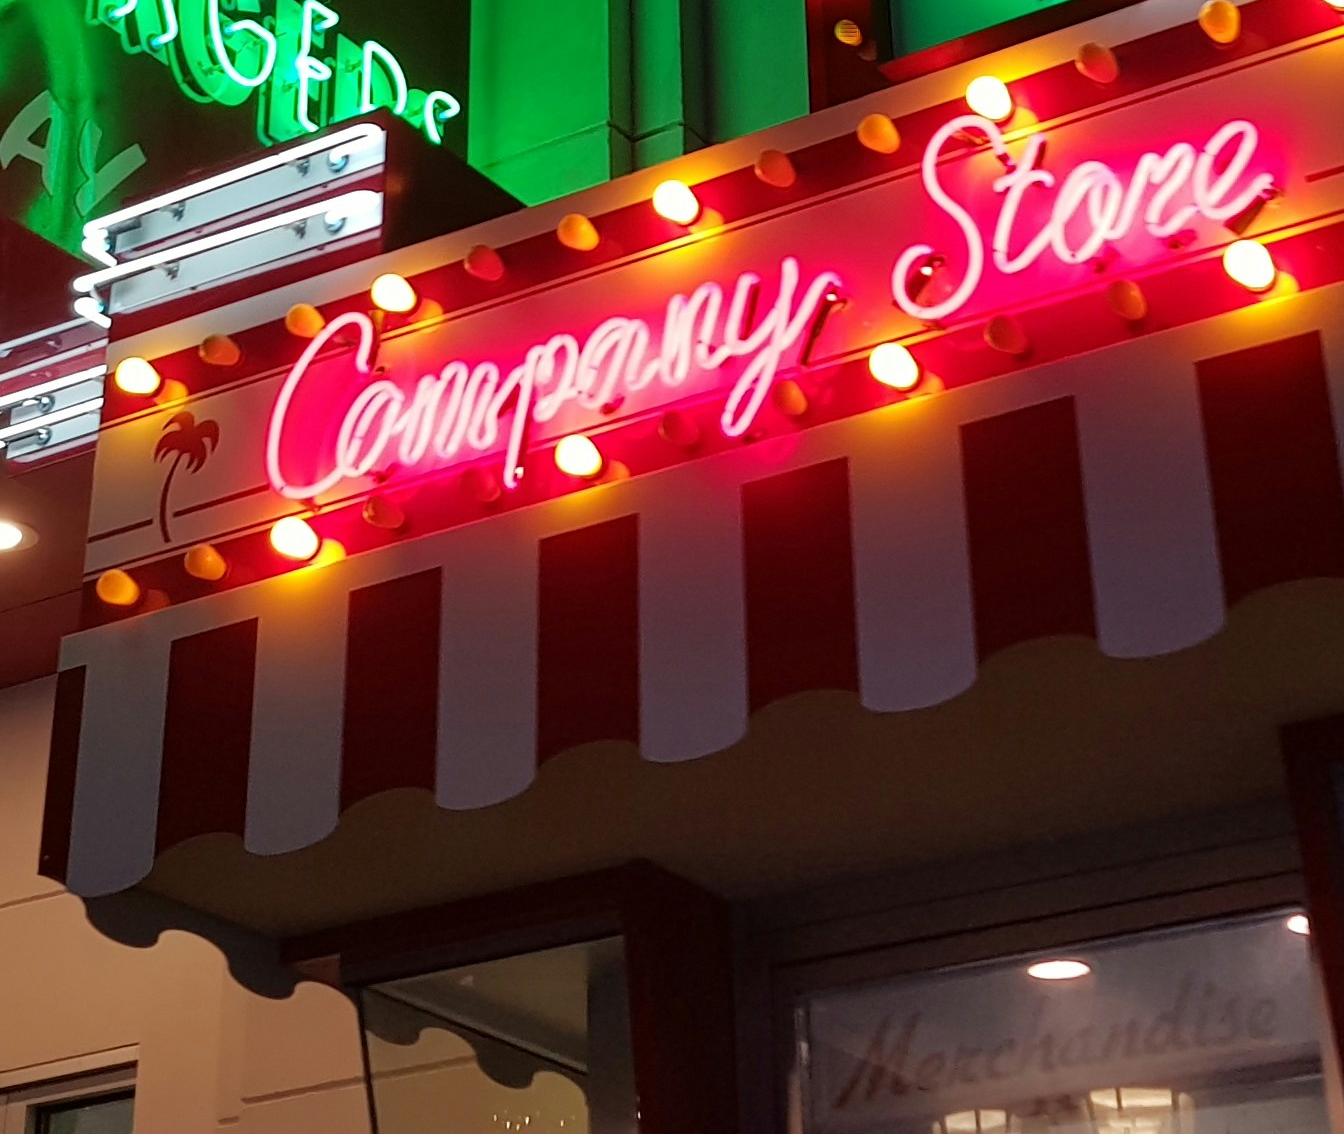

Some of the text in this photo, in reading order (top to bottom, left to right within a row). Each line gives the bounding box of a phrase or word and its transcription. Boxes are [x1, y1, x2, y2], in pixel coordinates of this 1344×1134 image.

[265, 115, 1283, 500] Company Store
[832, 975, 1277, 1109] Merchandise
